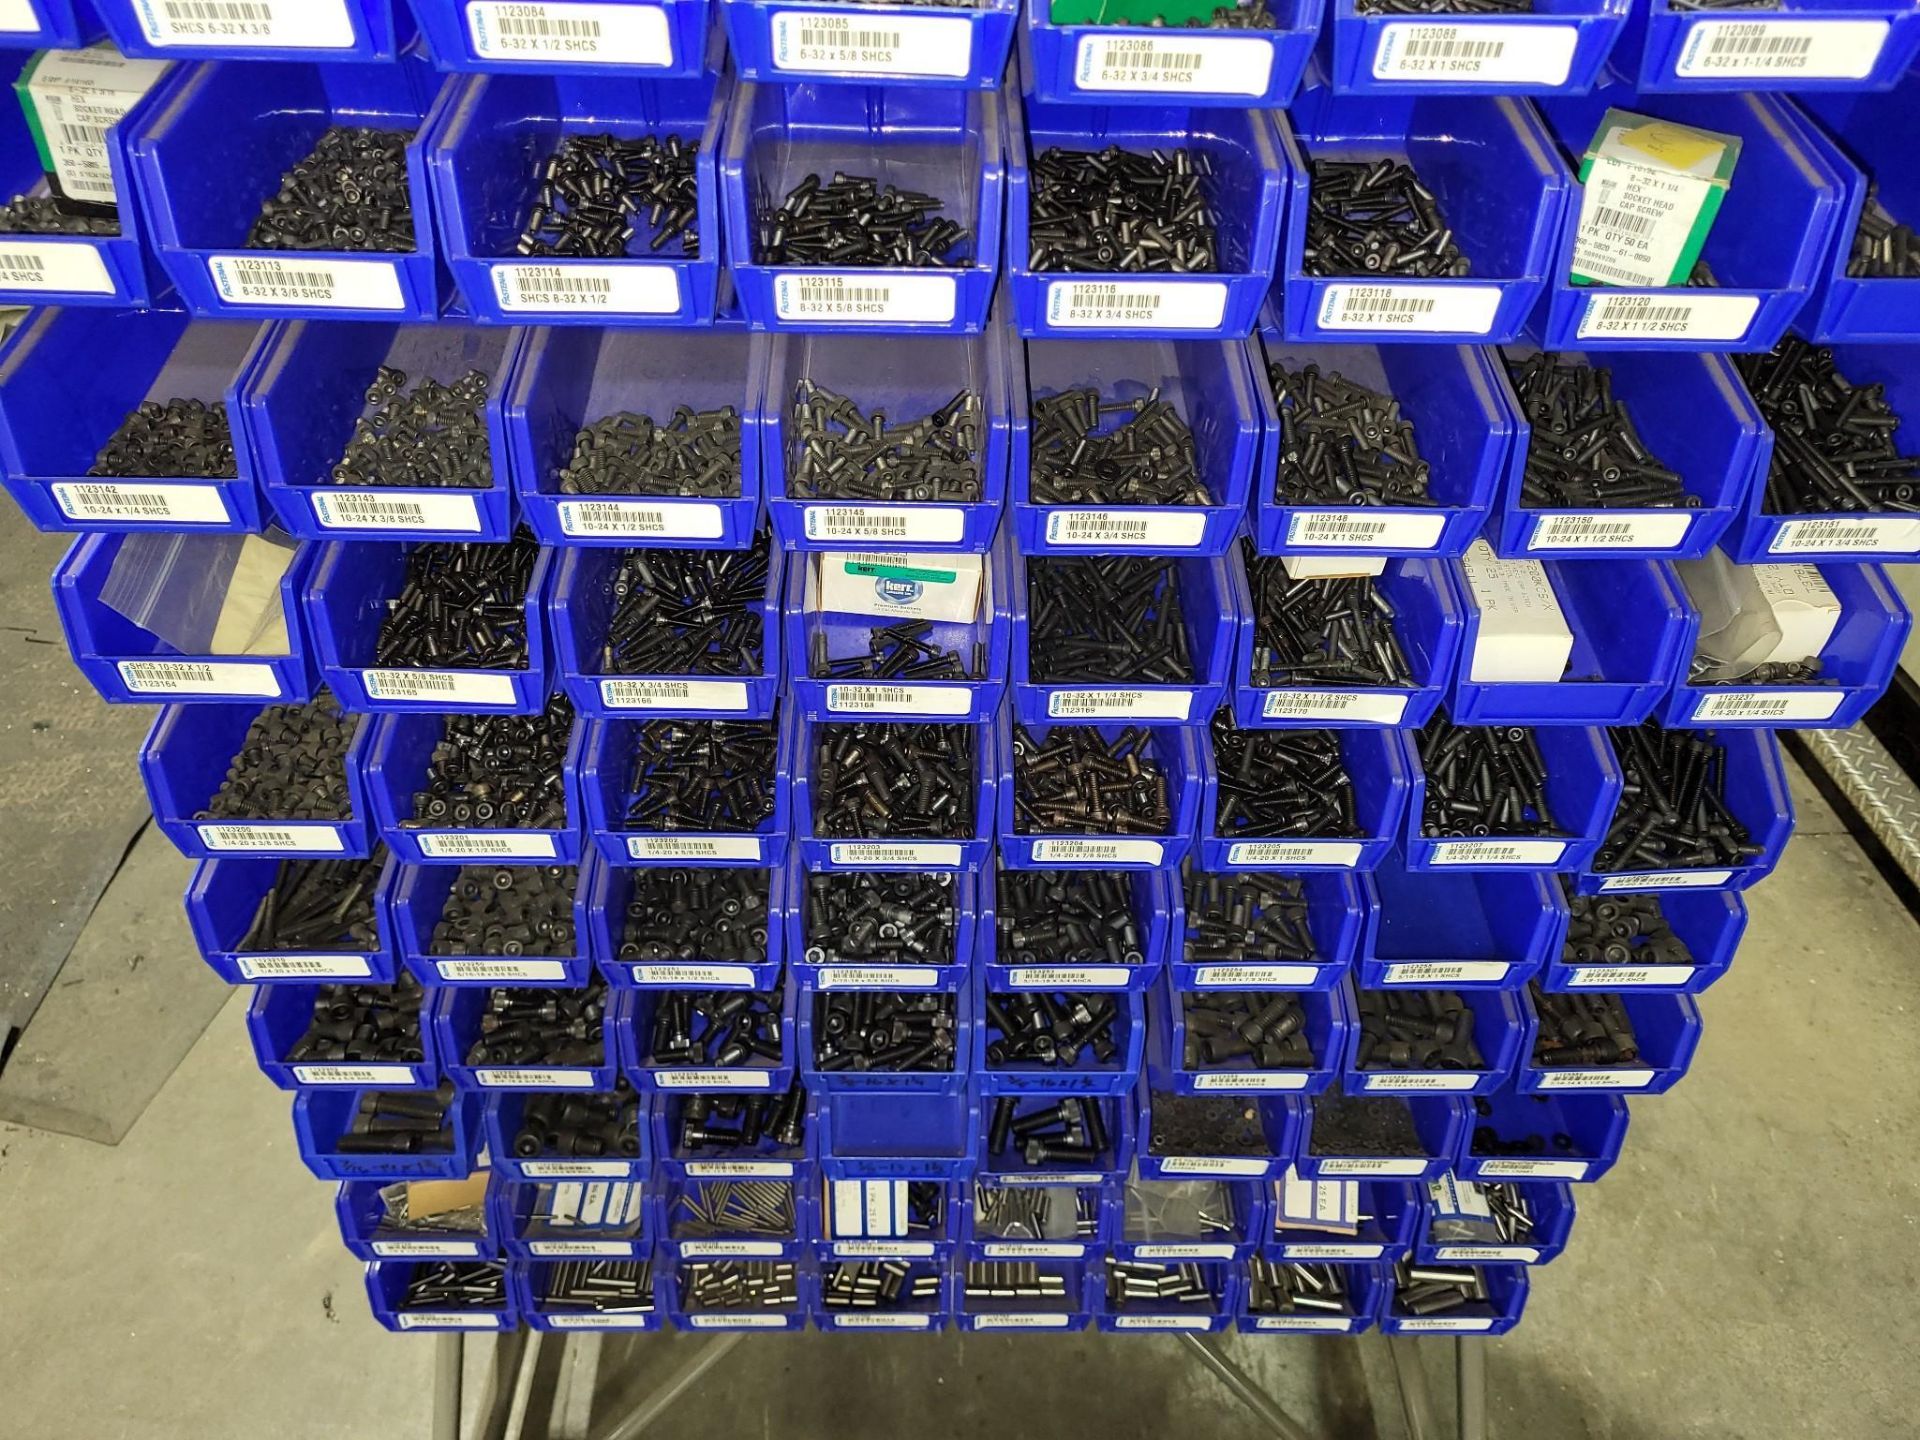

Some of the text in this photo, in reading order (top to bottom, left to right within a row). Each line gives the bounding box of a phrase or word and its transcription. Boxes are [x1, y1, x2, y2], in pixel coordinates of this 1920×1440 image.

[495, 6, 545, 17] 1123084
[171, 23, 270, 34] SHCS 6-32 X 3/8
[501, 39, 597, 51] 6-32 X 1/2 SHCS
[801, 49, 825, 60] 6-32
[840, 50, 857, 61] 5/8
[862, 50, 892, 62] SHCS
[1399, 60, 1424, 70] 6-32
[1429, 60, 1436, 70] X
[1449, 61, 1481, 71] SHCS
[1703, 56, 1808, 67] 6-32 x 1-1/4 SHCS
[1102, 70, 1193, 82] 6-32 X 3/4 SHCS
[69, 147, 80, 155] PK
[87, 149, 104, 157] QTY
[1626, 184, 1641, 193] HEX
[1667, 183, 1679, 192] 1/4
[1623, 192, 1674, 210] SOCKET HEAD
[1619, 201, 1664, 218] CAP SCREW
[1588, 227, 1598, 236] PK
[1605, 231, 1622, 241] QTY
[1624, 236, 1635, 246] 50
[1637, 240, 1649, 249] EA
[234, 260, 281, 270] 1123113
[12, 272, 44, 282] SHCS
[515, 267, 561, 277] 1123114
[799, 277, 843, 287] 1123115
[243, 286, 332, 299] 8-32 X 3/8 SHCS
[521, 293, 607, 304] SHCS 8-32 X 1/2
[1608, 297, 1651, 306] 1123120
[800, 303, 884, 312] 8-32 X 5/8 SHCS
[1070, 310, 1153, 319] 8-32 X 3/4 SHCS
[1342, 313, 1364, 322] 8-32
[1367, 314, 1374, 322] X
[1386, 314, 1414, 322] SHCS
[1596, 321, 1619, 330] 8-32
[1622, 322, 1630, 330] X
[1643, 322, 1657, 331] 1/2
[1659, 322, 1688, 331] SHCS
[75, 485, 118, 493] 1123142
[333, 494, 375, 502] 1123143
[84, 506, 113, 514] 10-24
[125, 507, 140, 515] 1/4
[144, 507, 171, 515] SHCS
[340, 514, 367, 522] 10-24
[380, 515, 396, 523] 3/8
[399, 515, 425, 523] SHCS
